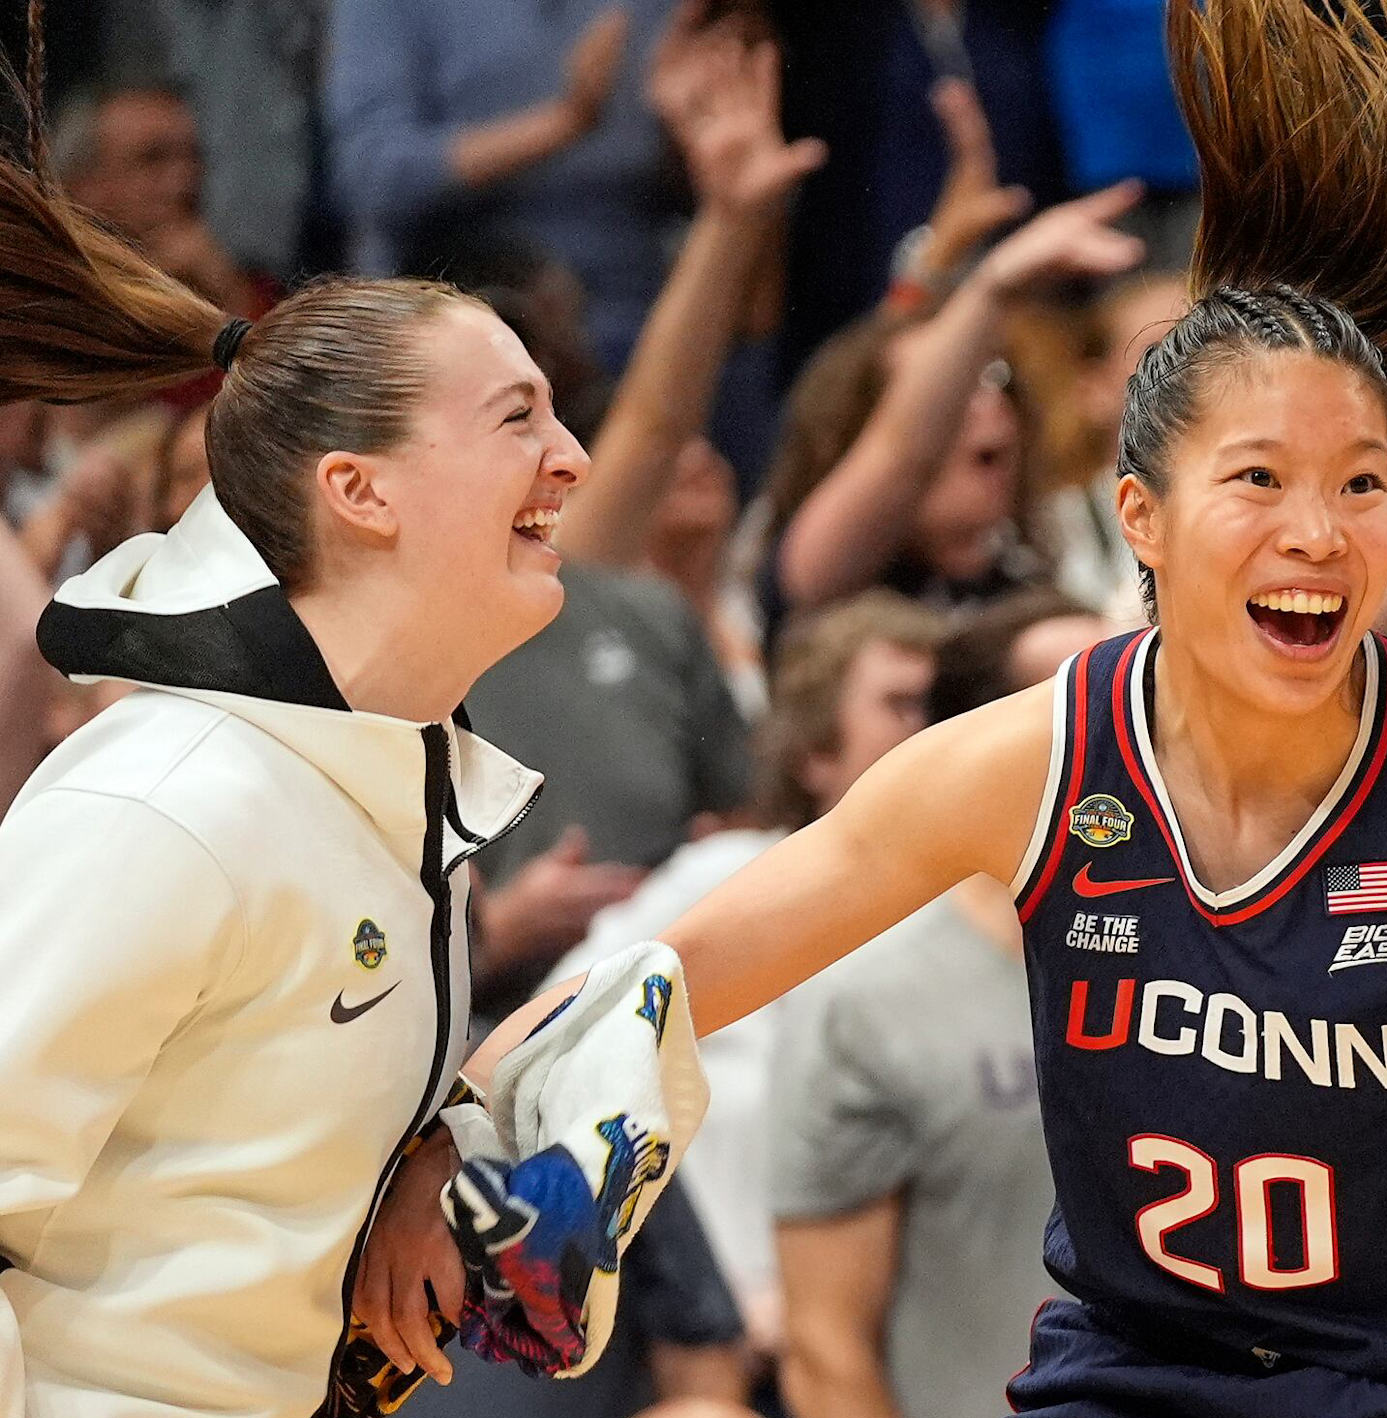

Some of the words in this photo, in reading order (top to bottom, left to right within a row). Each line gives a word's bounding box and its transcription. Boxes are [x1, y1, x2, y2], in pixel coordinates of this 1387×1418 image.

[1074, 814, 1100, 826] FINAL
[1102, 816, 1127, 831] FOUR
[1073, 913, 1098, 932] BE
[1103, 917, 1139, 935] THE
[1065, 930, 1140, 953] CHANGE
[1128, 1133, 1339, 1293] 20
